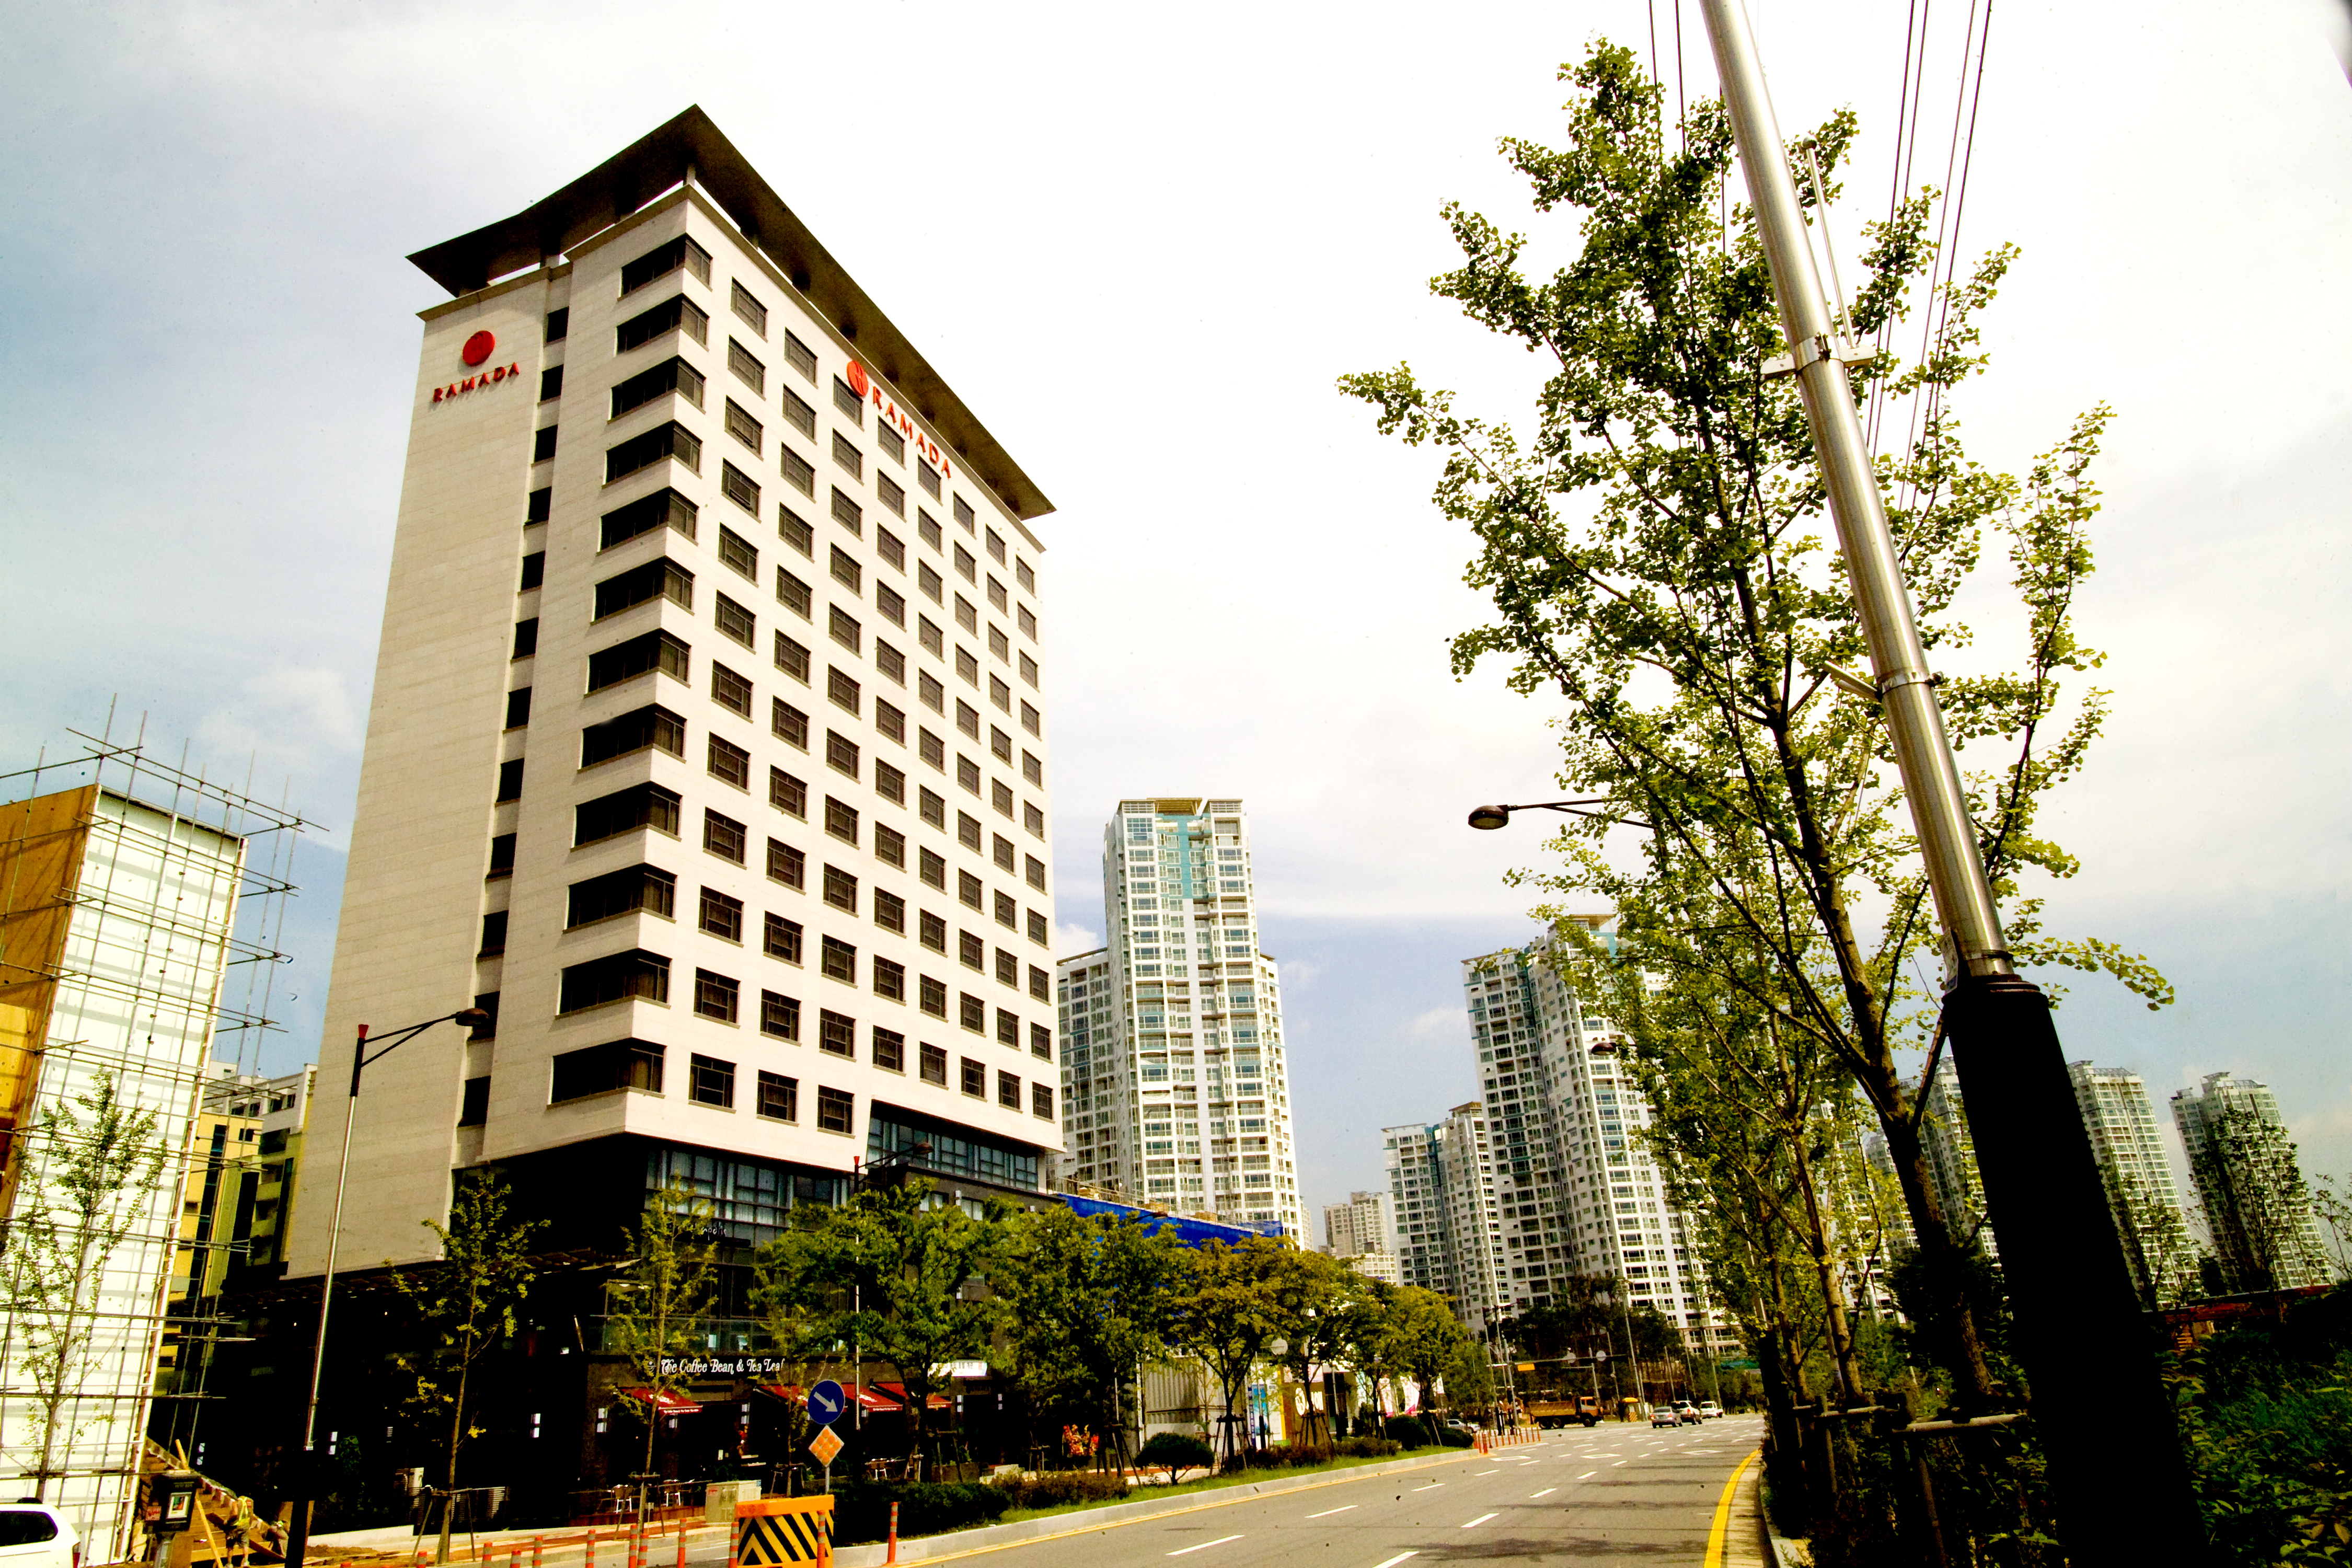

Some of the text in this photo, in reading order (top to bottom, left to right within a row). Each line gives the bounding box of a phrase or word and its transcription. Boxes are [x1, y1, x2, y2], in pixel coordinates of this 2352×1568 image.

[433, 362, 520, 403] RAMADA
[872, 386, 951, 479] RAMADA
[661, 1358, 677, 1375] The
[679, 1358, 707, 1373] Coffee
[710, 1358, 734, 1375] Bean
[736, 1358, 744, 1373] &
[746, 1359, 762, 1372] Tea
